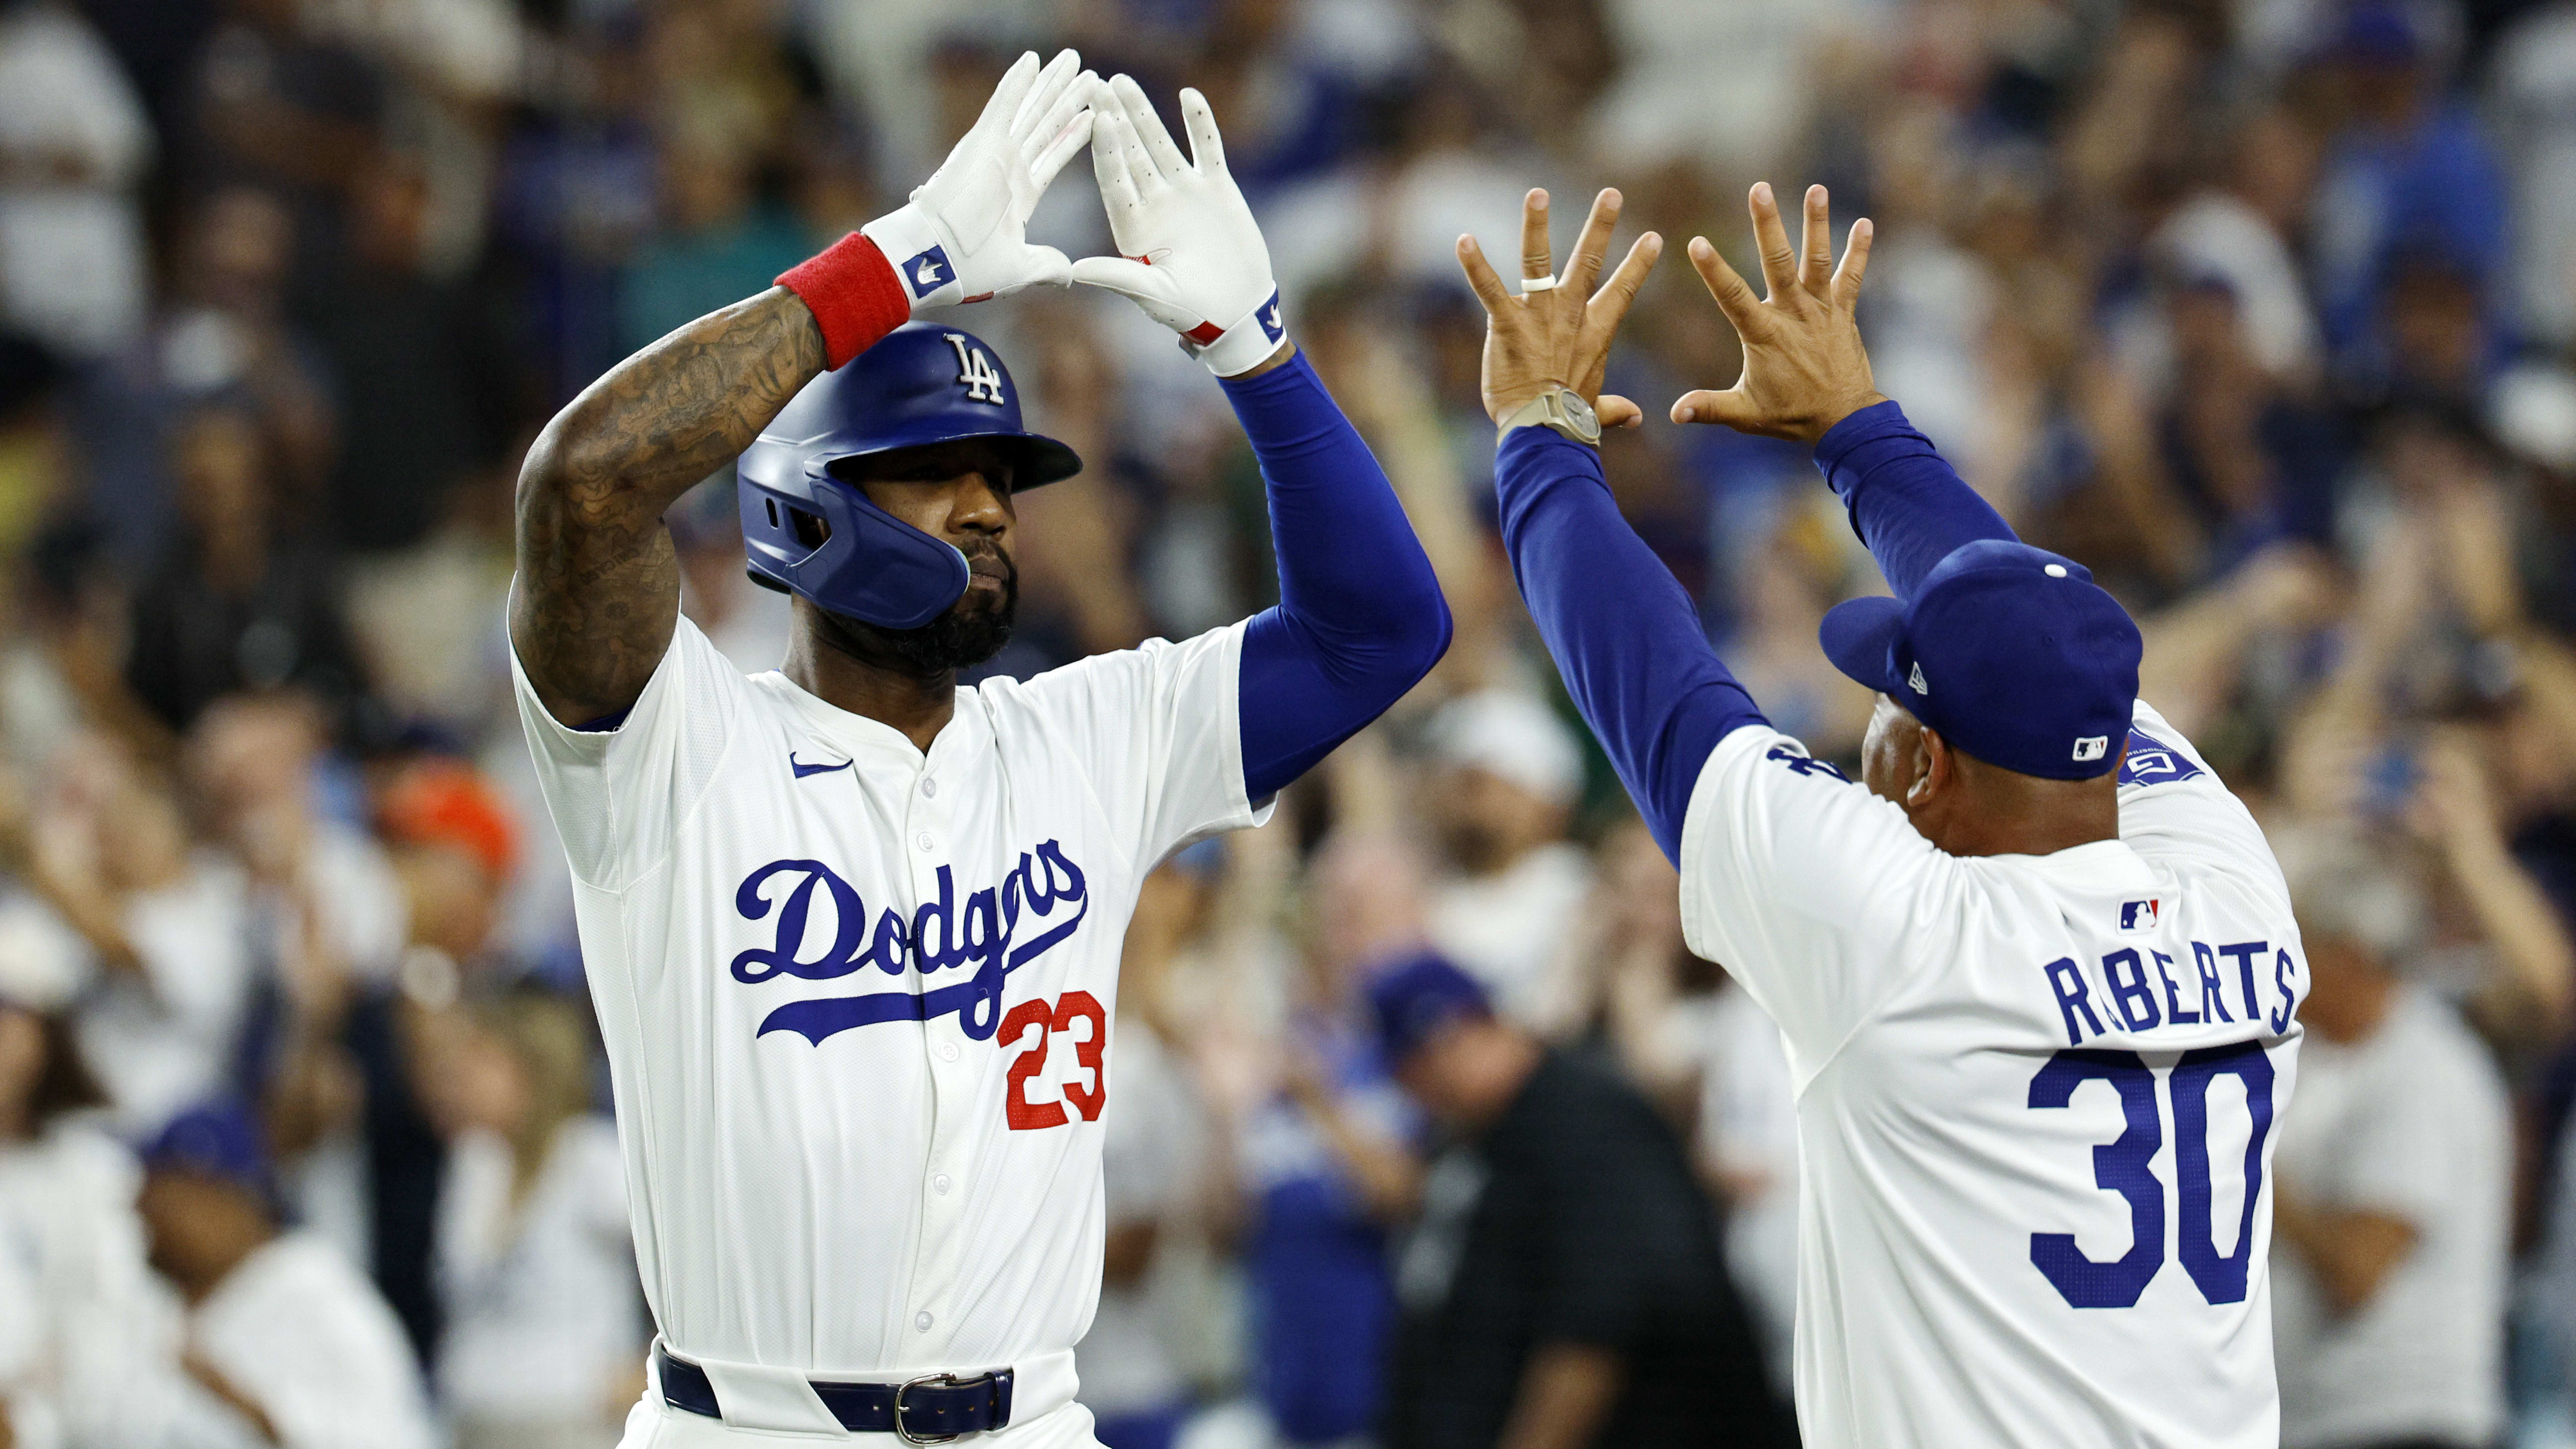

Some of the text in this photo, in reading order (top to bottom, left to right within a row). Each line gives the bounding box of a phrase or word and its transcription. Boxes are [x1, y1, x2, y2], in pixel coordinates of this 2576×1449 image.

[943, 332, 1004, 405] LA
[730, 838, 1088, 1047] Dodgers
[2043, 941, 2295, 1047] RBERTS
[996, 990, 1106, 1130] 23
[2027, 1040, 2275, 1308] 30
